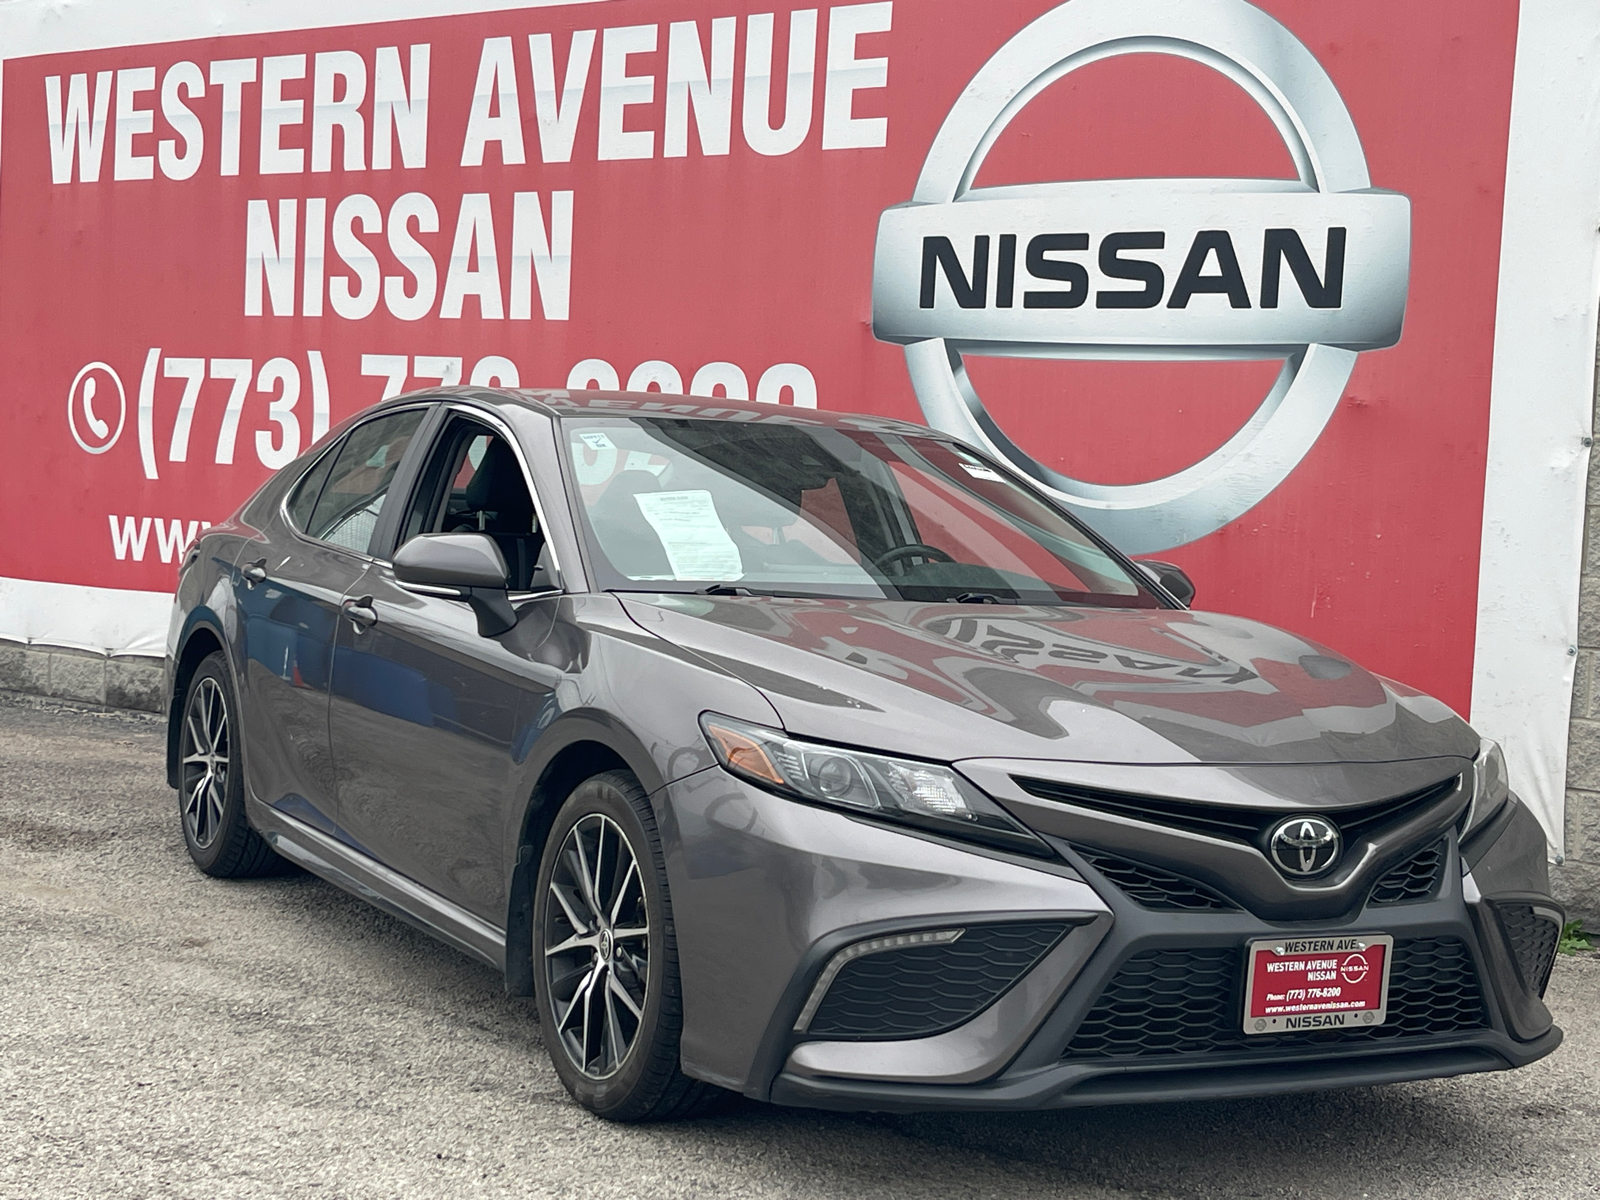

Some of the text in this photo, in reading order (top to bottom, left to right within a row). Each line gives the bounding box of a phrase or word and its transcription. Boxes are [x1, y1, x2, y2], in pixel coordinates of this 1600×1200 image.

[45, 0, 894, 185] WESTERN AVENUE
[244, 190, 574, 321] NISSAN
[919, 227, 1347, 309] NISSAN
[138, 347, 330, 480] (773)
[1284, 940, 1335, 953] WESTERN
[1266, 959, 1338, 973] WESTERN AVENUE
[1307, 970, 1337, 982] NISSAN
[1286, 989, 1306, 1002] (773)
[1307, 986, 1342, 999] 776-8200
[1265, 1000, 1366, 1014] www.westernavenissan.com
[1285, 1013, 1346, 1029] NISSAN
